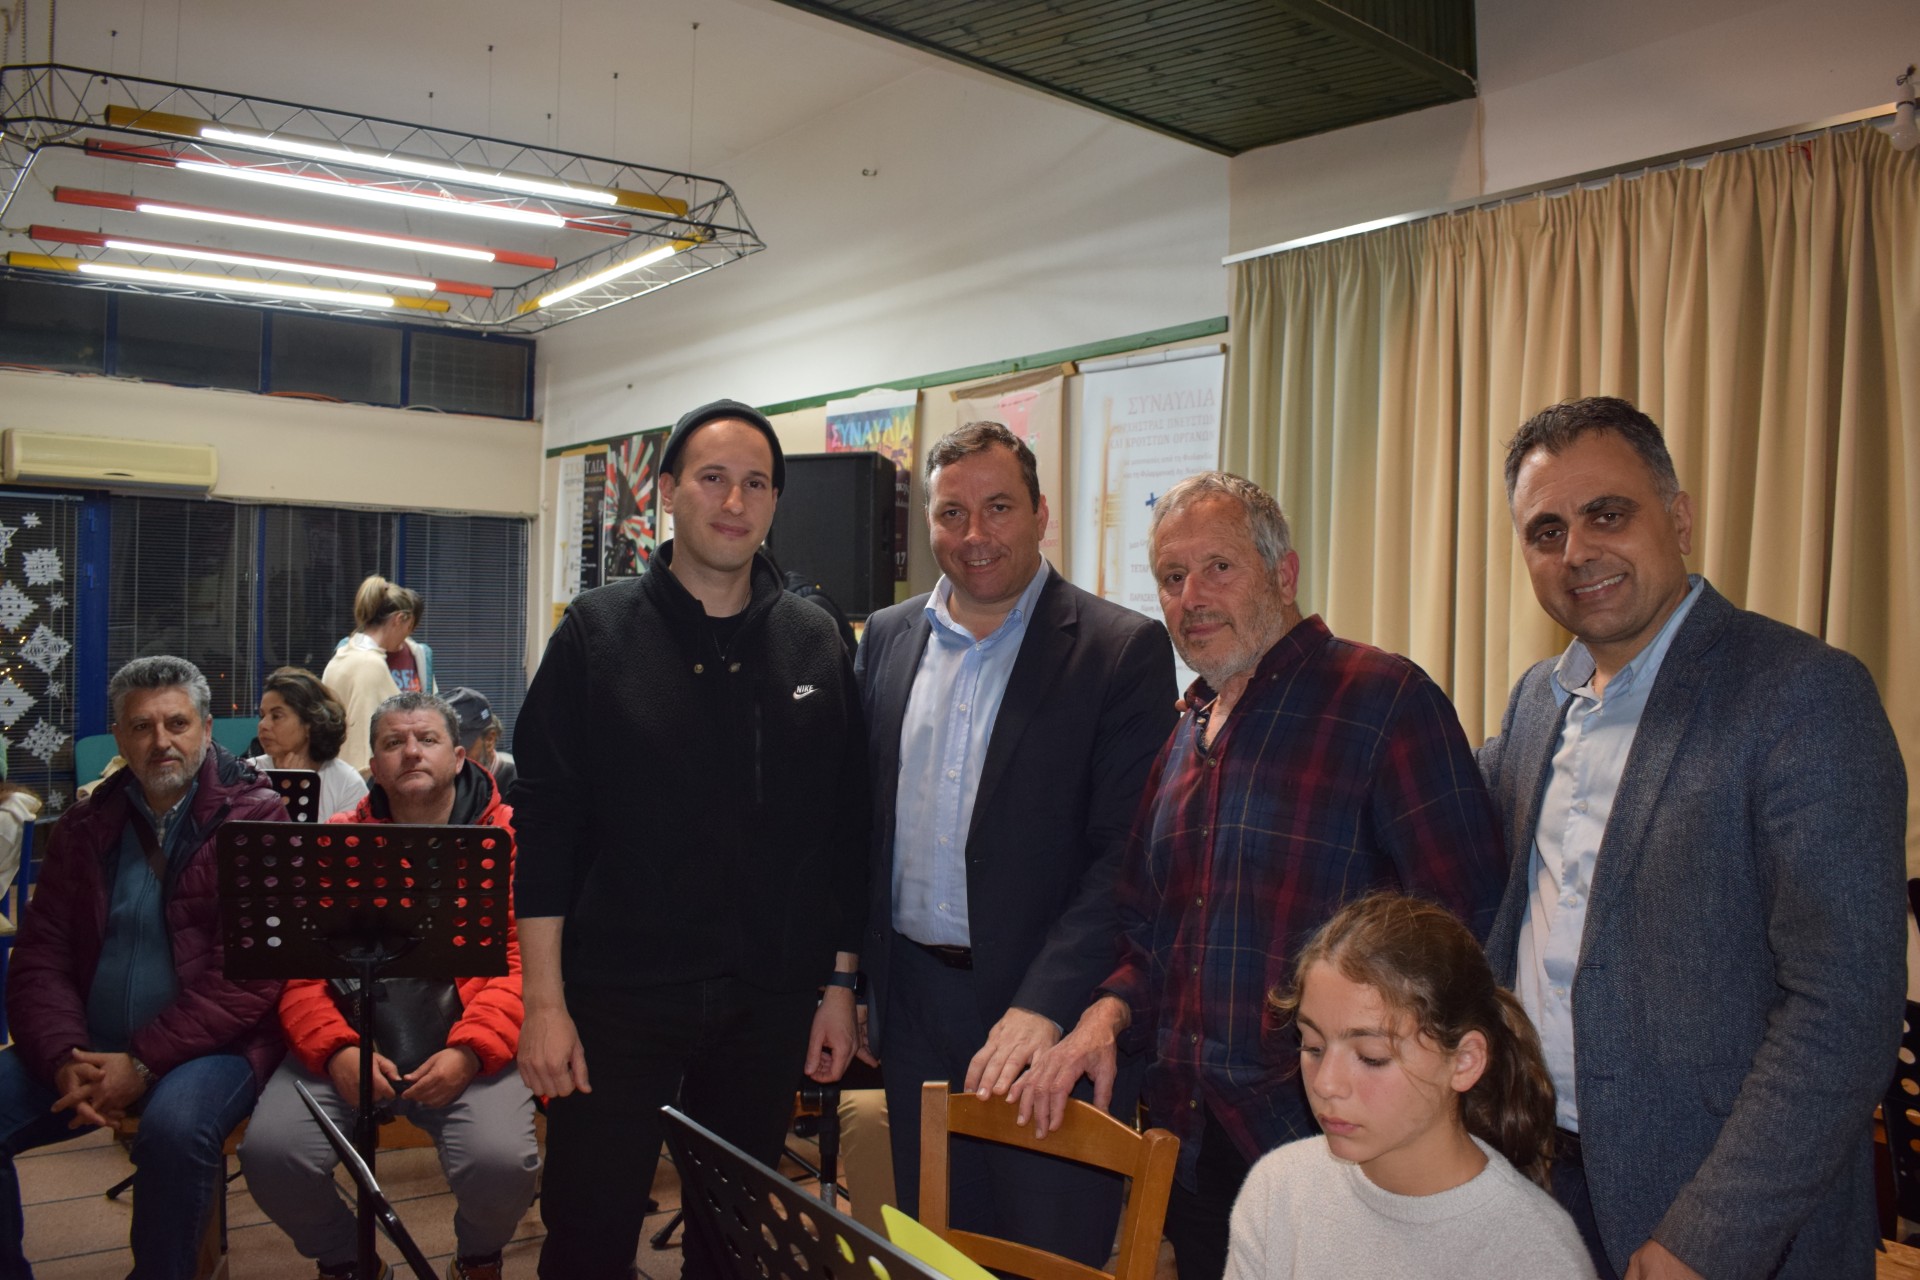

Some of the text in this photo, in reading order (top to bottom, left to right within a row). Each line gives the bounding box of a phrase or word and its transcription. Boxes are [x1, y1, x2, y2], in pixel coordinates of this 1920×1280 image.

[1128, 388, 1216, 416] ΣΥΝΑΥΛΙΑ
[831, 415, 914, 449] ΣΥΝΑΥΛΙΑ
[796, 684, 815, 694] NIKE
